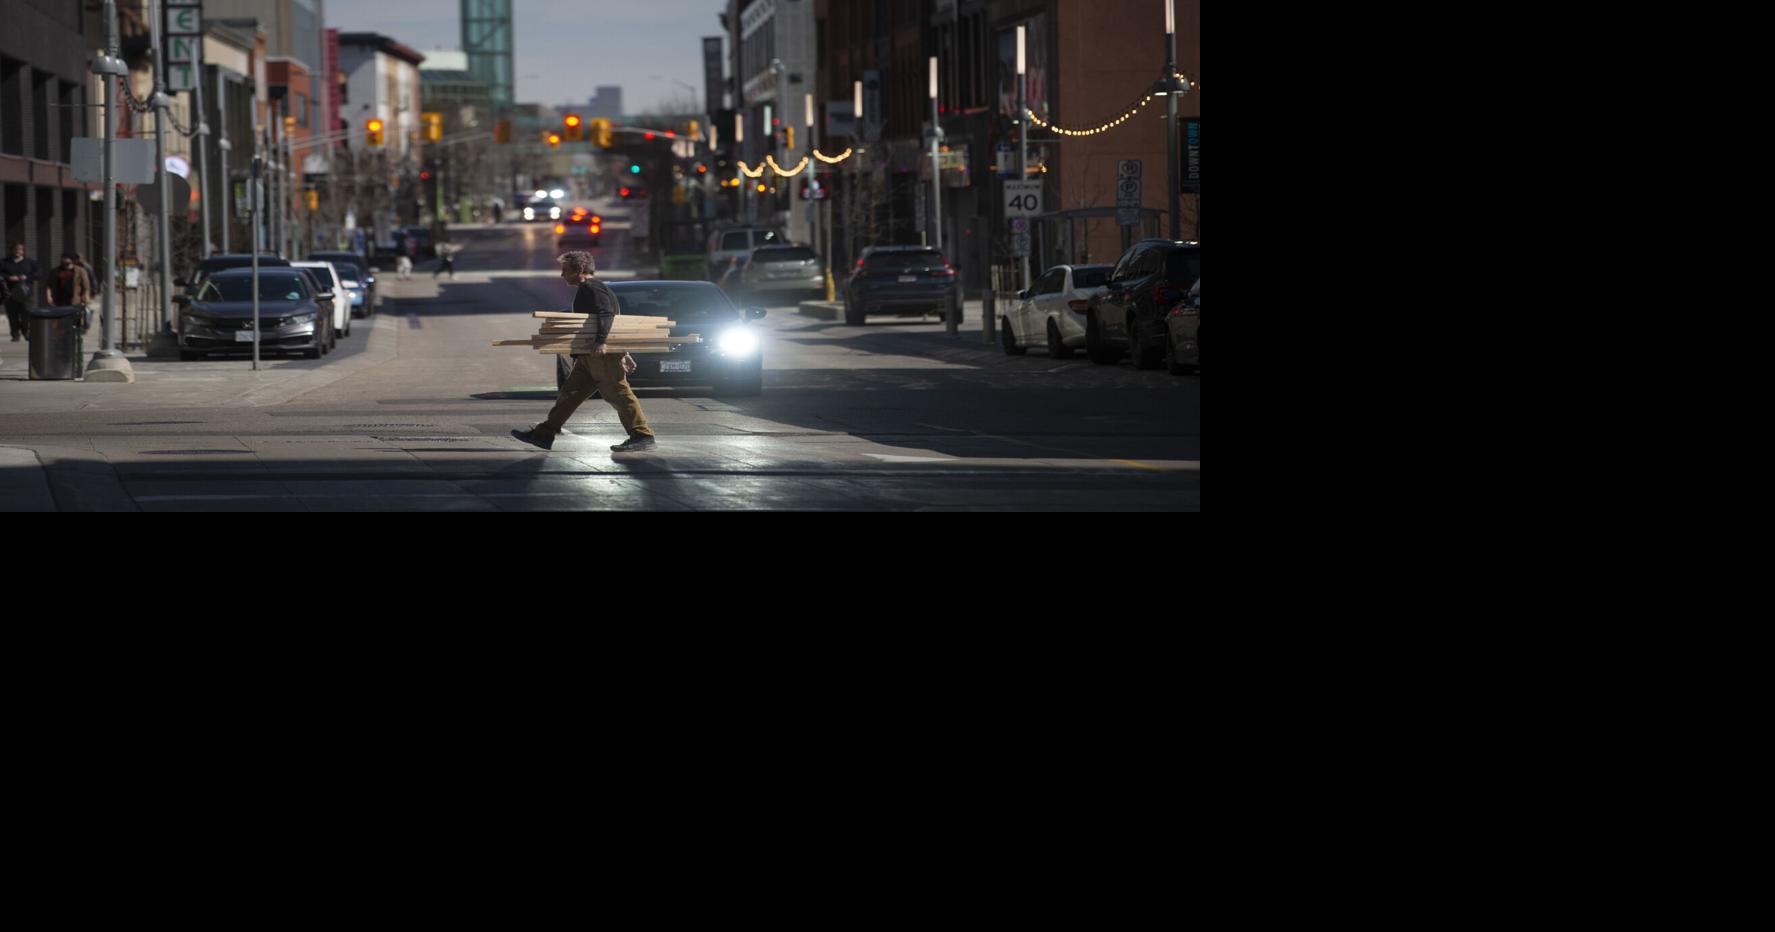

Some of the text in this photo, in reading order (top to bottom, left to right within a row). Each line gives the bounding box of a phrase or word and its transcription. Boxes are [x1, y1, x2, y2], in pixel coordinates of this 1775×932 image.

[174, 1, 193, 88] ENT
[1188, 122, 1199, 179] DOWNTOWN
[1008, 194, 1038, 211] 40
